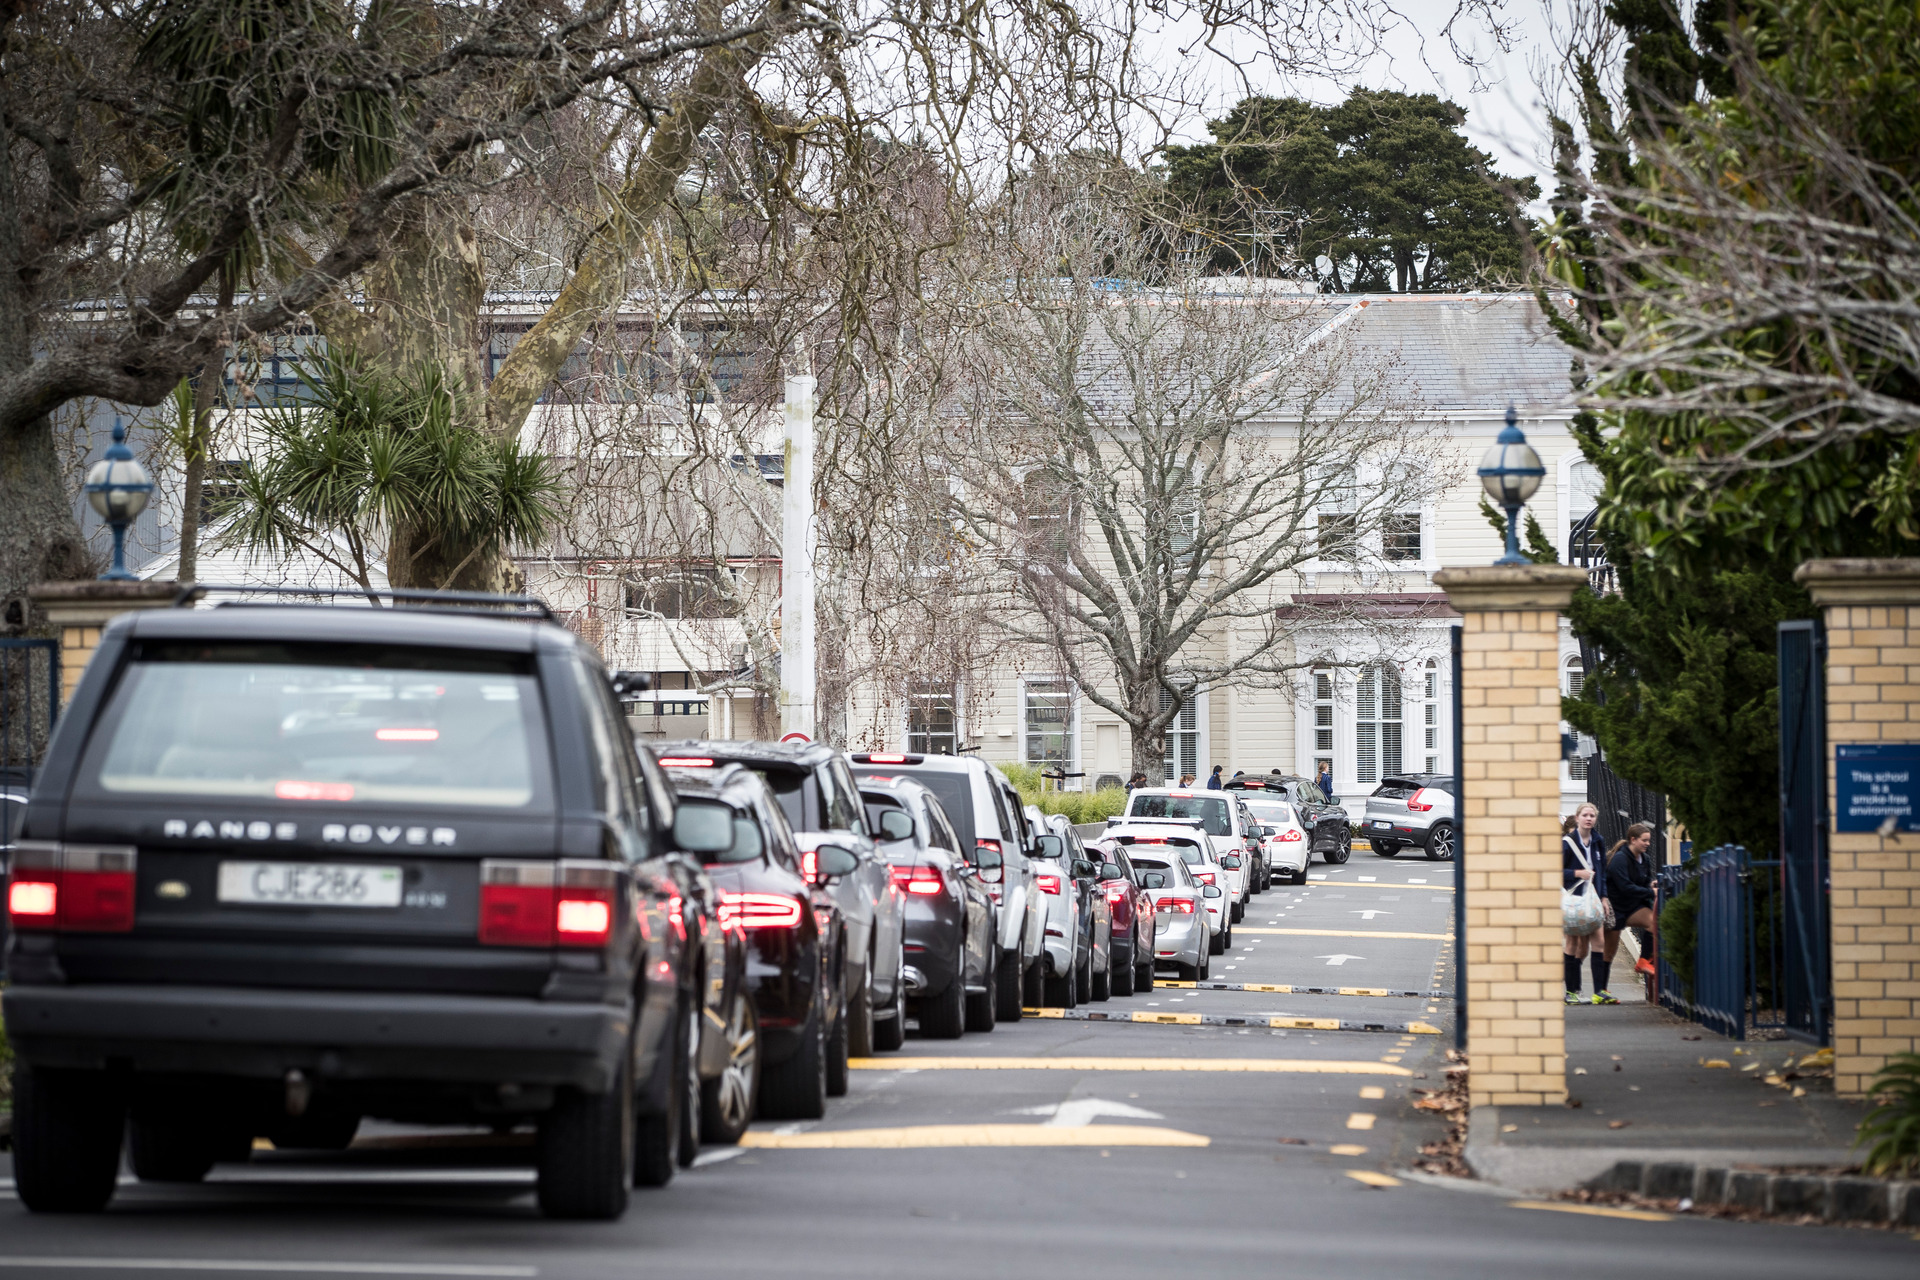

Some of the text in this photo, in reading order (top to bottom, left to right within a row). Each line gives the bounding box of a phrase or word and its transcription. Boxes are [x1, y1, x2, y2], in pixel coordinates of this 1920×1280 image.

[1851, 770, 1909, 782] This school
[1870, 784, 1890, 793] is a
[1848, 806, 1912, 816] environment
[164, 819, 456, 846] RANGE ROVER
[253, 866, 369, 900] CJE286
